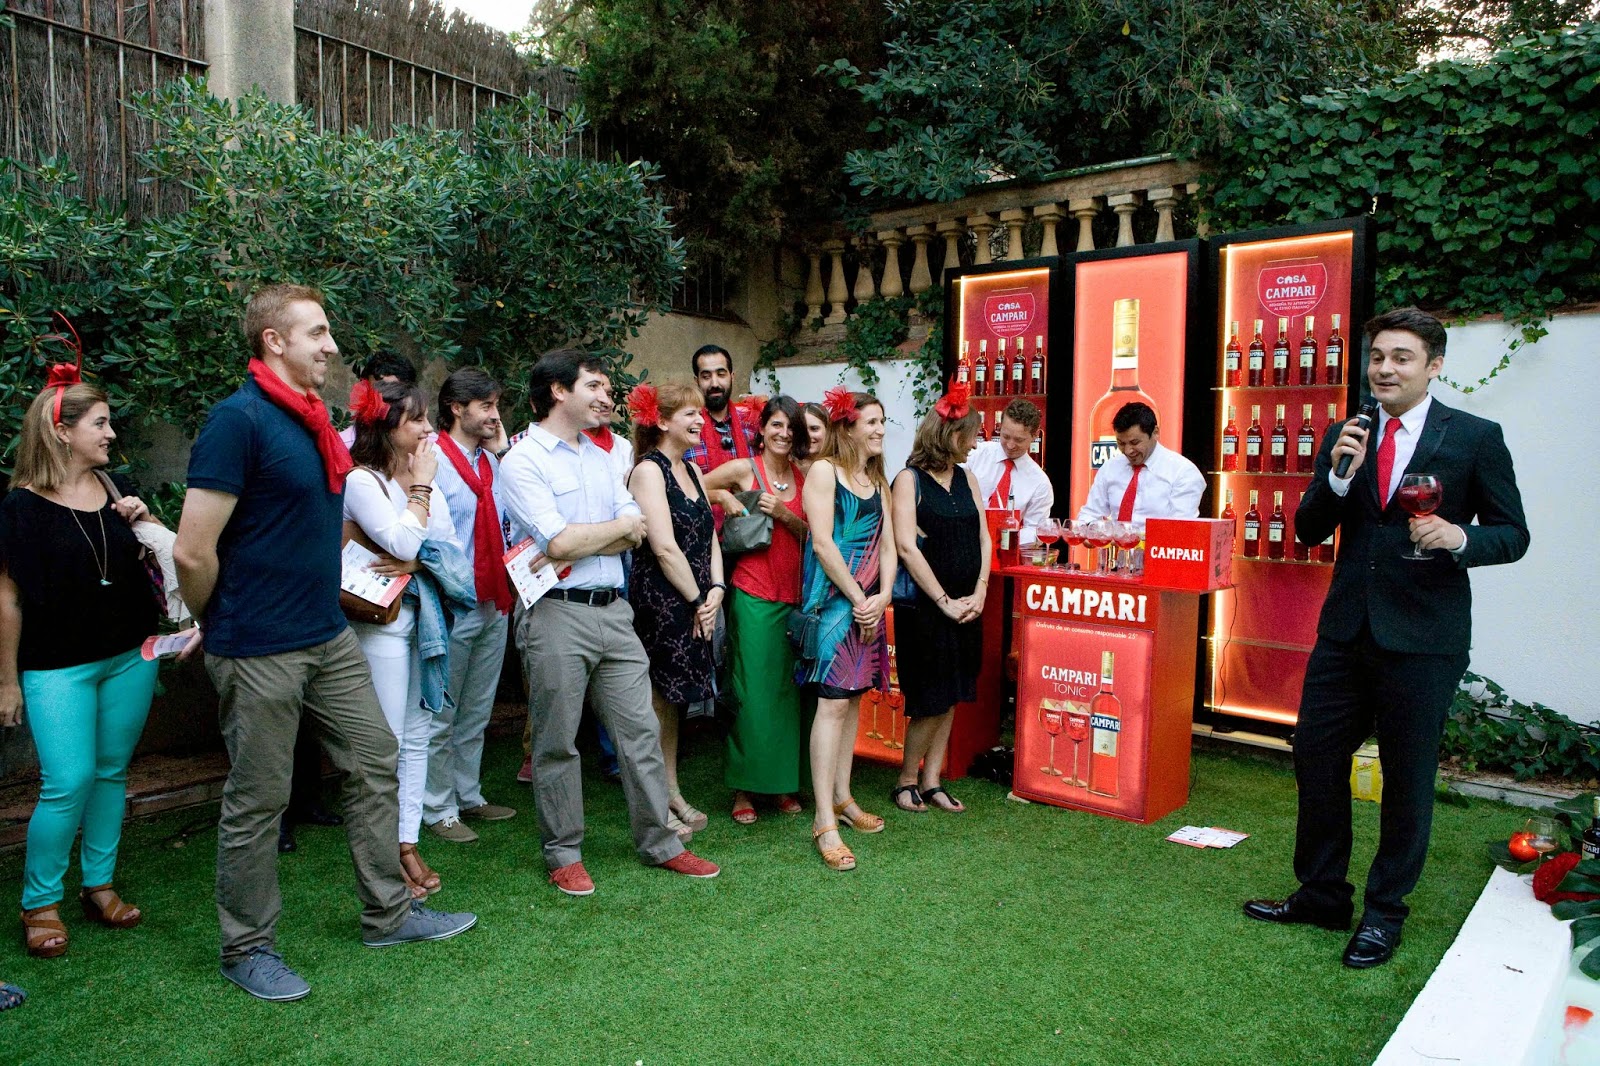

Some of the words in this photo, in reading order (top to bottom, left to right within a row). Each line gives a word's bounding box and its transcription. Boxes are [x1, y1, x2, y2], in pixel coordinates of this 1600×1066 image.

[1276, 274, 1308, 285] CASA
[1265, 285, 1316, 300] CAMPARI
[997, 302, 1021, 311] CASA
[990, 311, 1028, 323] CAMPARI
[1150, 546, 1204, 562] CAMPARI
[1026, 584, 1148, 623] CAMPARI
[1071, 627, 1095, 635] consumo
[1094, 630, 1127, 639] responsable
[1041, 665, 1098, 686] CAMPARI
[1053, 682, 1087, 698] TONIC
